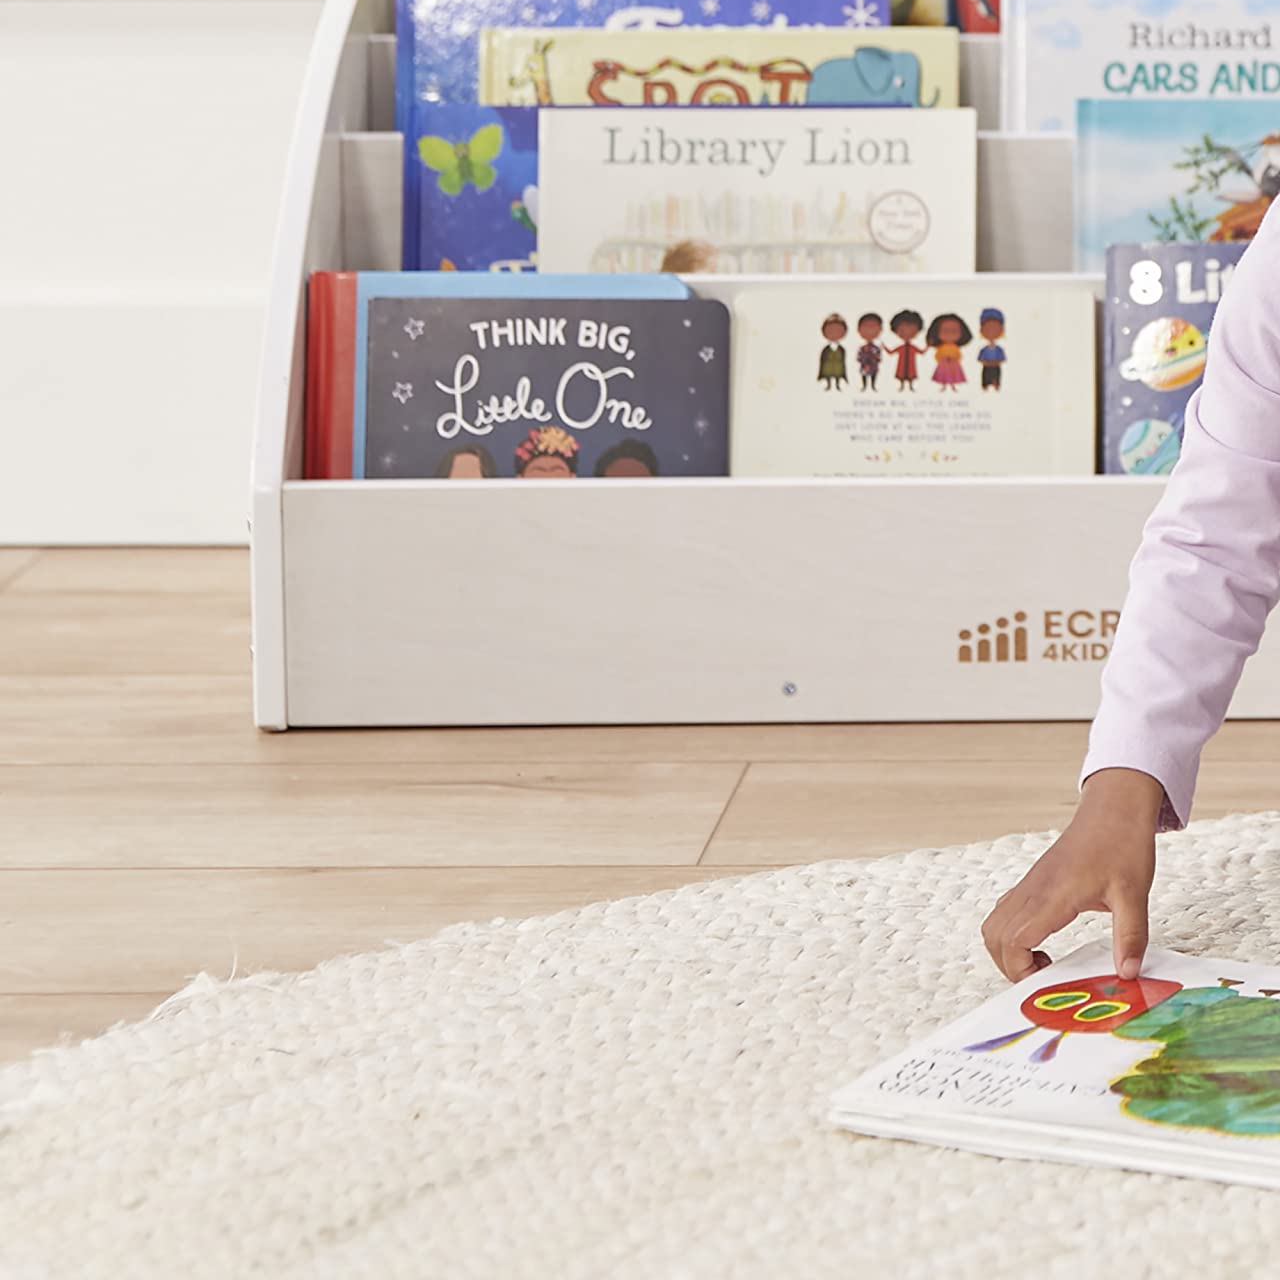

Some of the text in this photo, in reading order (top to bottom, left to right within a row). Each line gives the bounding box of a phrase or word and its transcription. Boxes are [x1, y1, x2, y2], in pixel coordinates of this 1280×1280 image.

[1129, 22, 1271, 51] Richard
[1103, 61, 1198, 94] CARS
[602, 126, 913, 178] Library Lion
[1129, 260, 1163, 305] 8
[469, 317, 637, 362] THINK BIG,
[434, 353, 653, 439] Little One
[1043, 609, 1121, 639] ECR
[1042, 642, 1109, 662] 4KID
